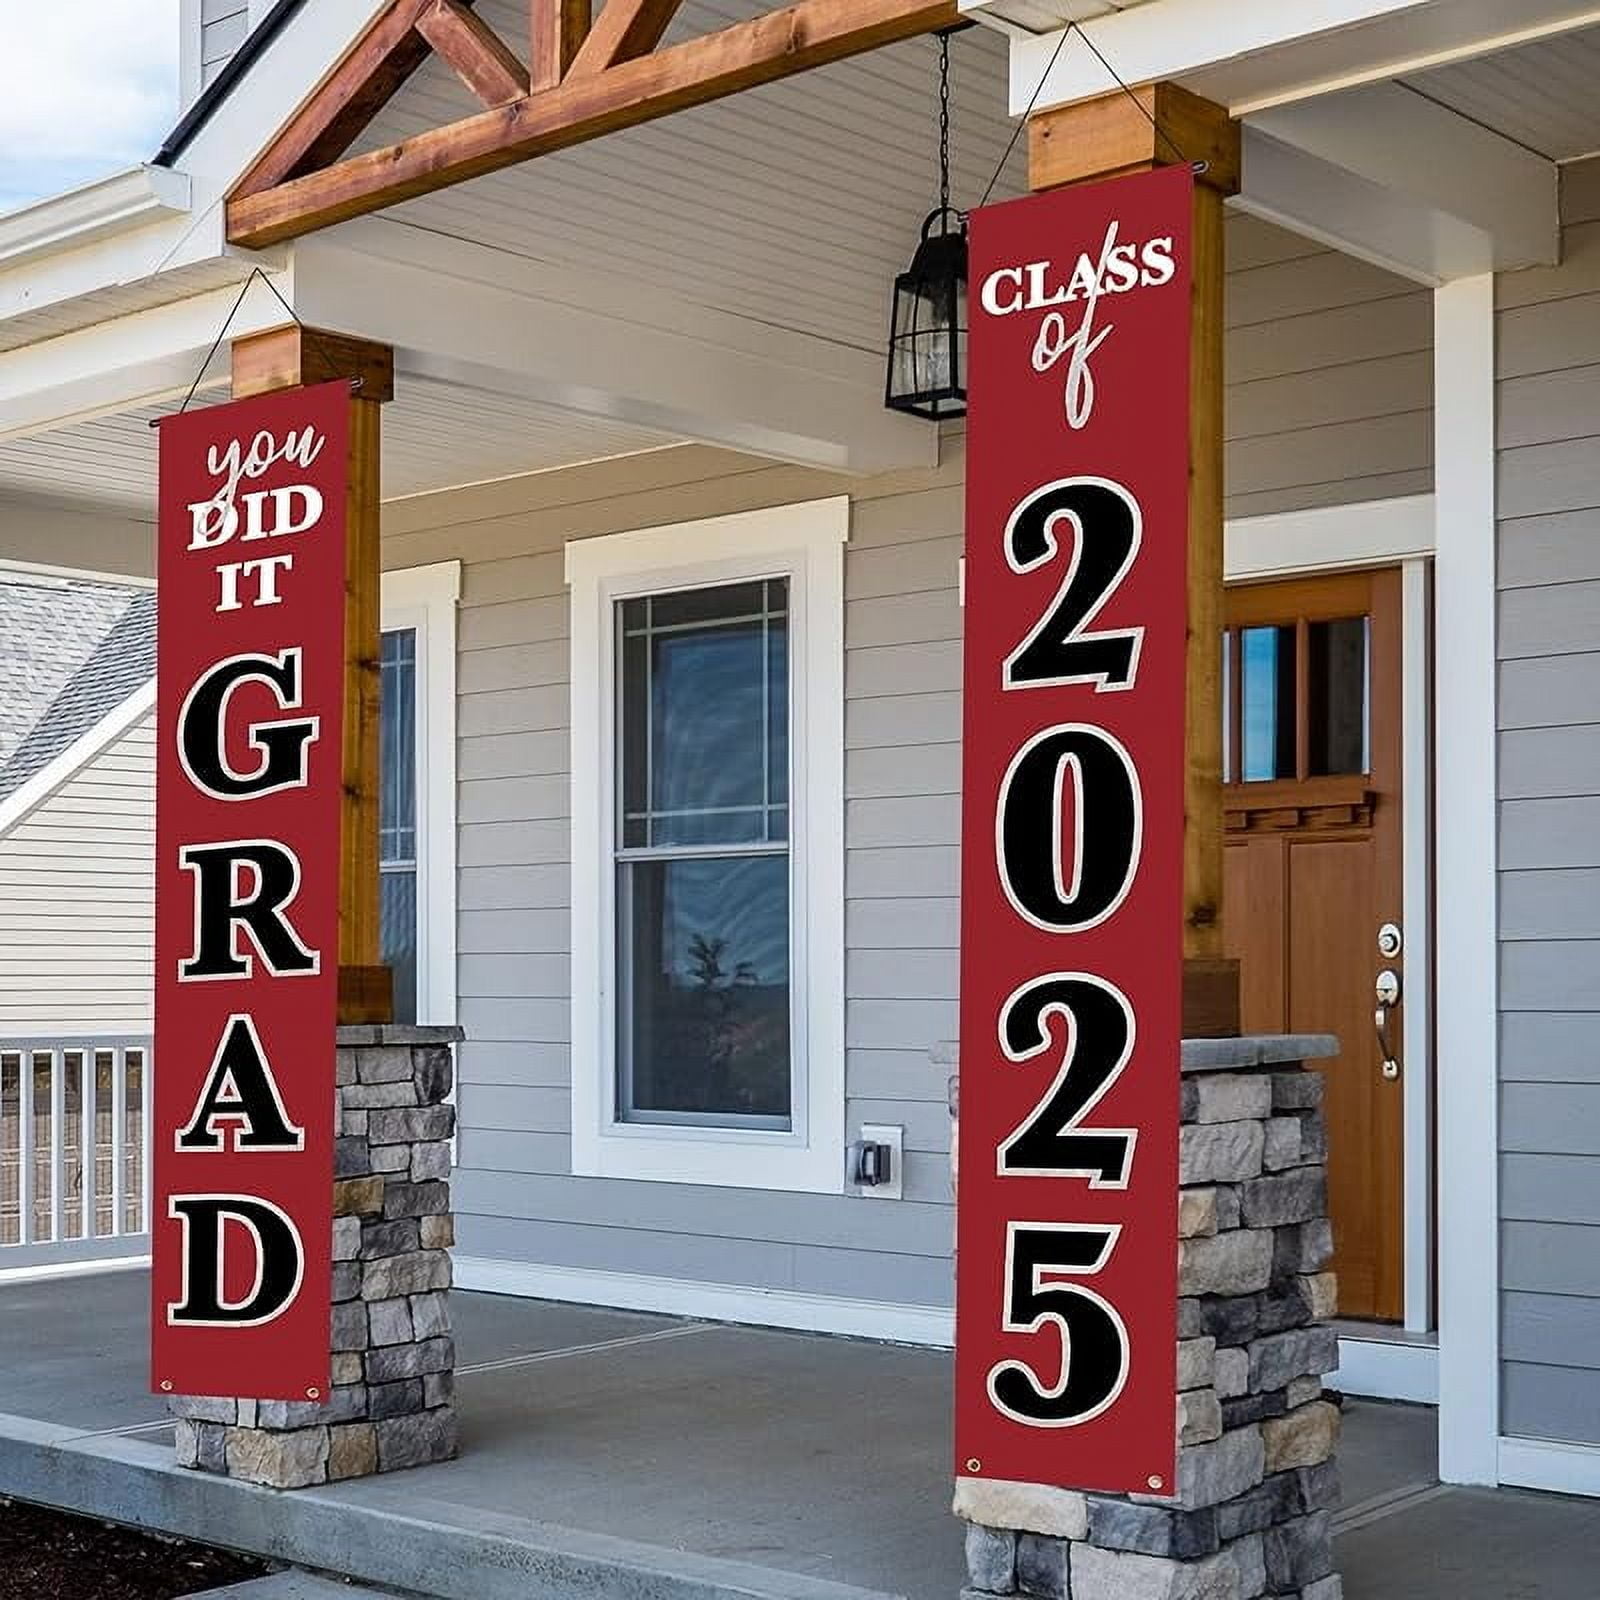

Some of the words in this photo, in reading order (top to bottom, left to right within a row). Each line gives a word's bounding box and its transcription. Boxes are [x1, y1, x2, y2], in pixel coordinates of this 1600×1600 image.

[980, 236, 1175, 316] CLASS
[1031, 220, 1113, 430] of
[187, 484, 324, 551] DID
[207, 425, 326, 535] you
[215, 554, 293, 612] IT
[168, 647, 321, 1328] GRAD
[986, 475, 1145, 1428] 2025
